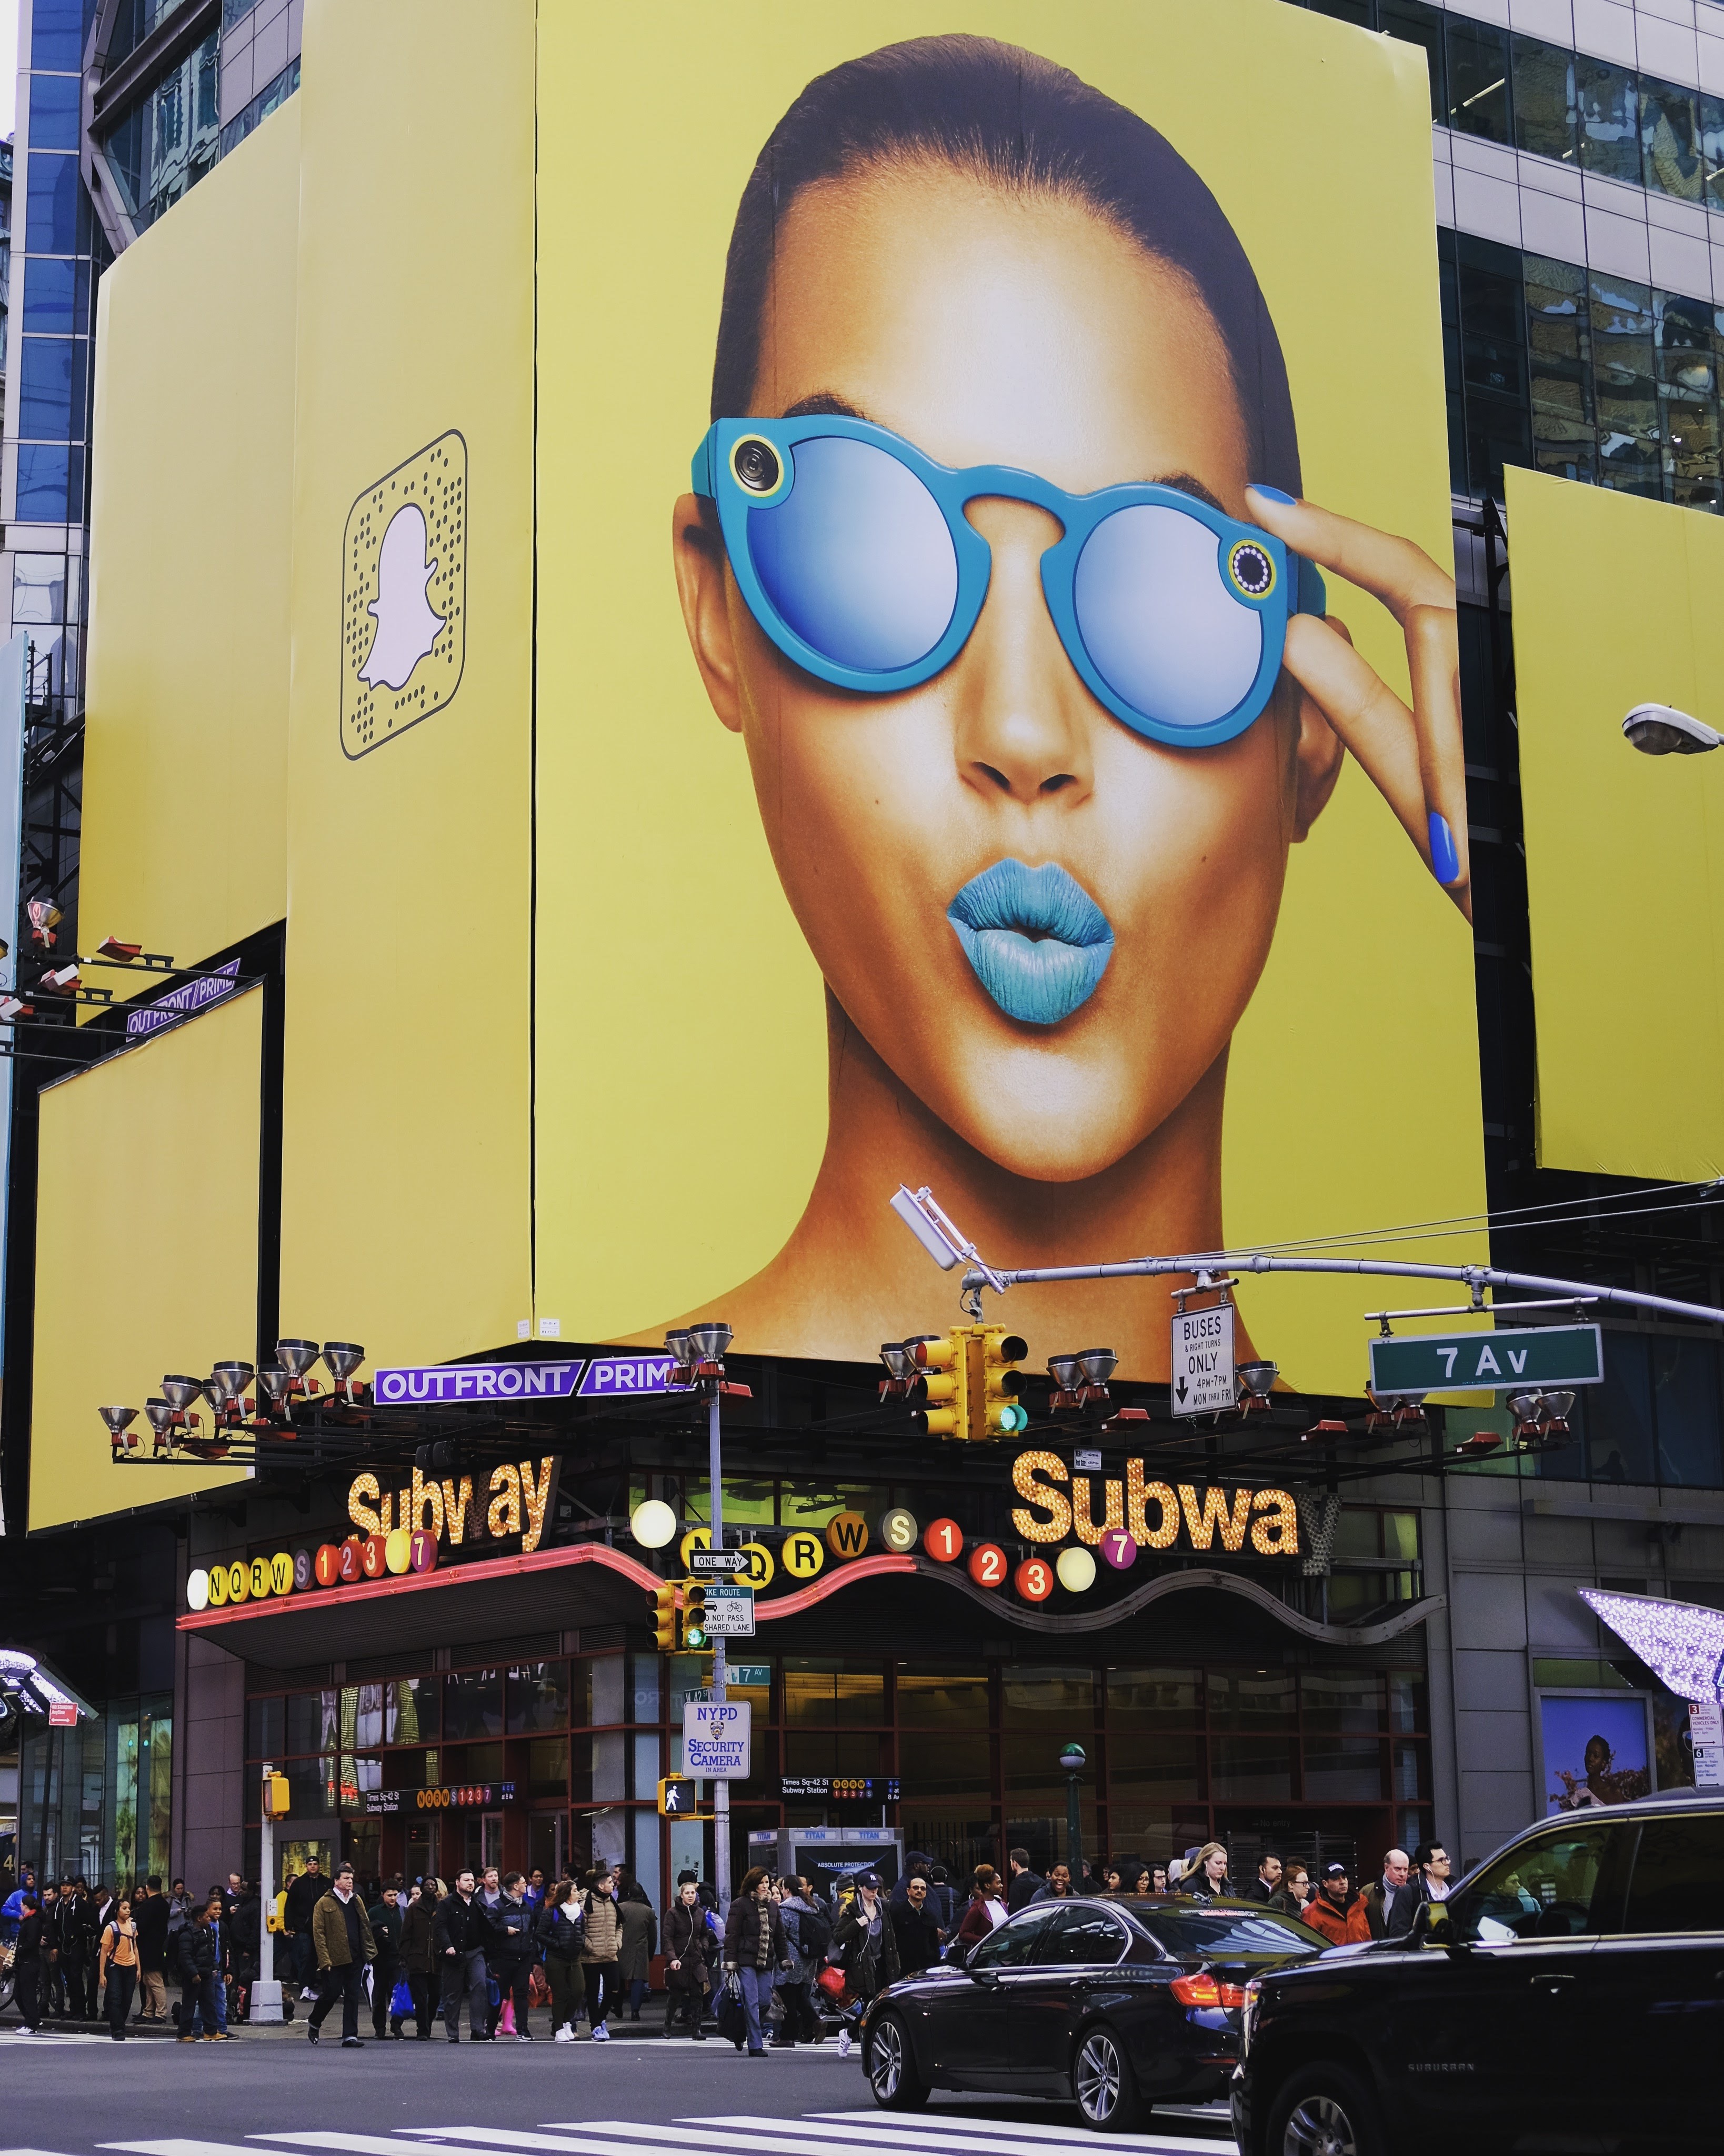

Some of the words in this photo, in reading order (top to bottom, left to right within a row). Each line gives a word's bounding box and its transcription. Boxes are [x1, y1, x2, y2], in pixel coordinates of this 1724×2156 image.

[199, 966, 235, 1002] PRIME
[1184, 1316, 1221, 1340] BUSES
[1190, 1342, 1204, 1352] RIGHT
[1205, 1339, 1221, 1349] TURNS
[1189, 1352, 1218, 1374] ONLY
[1437, 1348, 1458, 1378] 7
[1475, 1345, 1528, 1376] Av
[382, 1365, 571, 1400] OUTFRONT
[1197, 1375, 1227, 1389] 4PM-7PM
[1193, 1393, 1207, 1405] MON
[1209, 1392, 1219, 1401] THRU
[1221, 1389, 1231, 1401] FRI
[348, 1455, 554, 1553] Subway
[699, 1557, 717, 1566] ONE
[725, 1557, 743, 1566] WAY
[795, 1540, 816, 1569] R
[836, 1522, 865, 1553] W
[891, 1515, 910, 1545] S
[940, 1525, 953, 1554] 1
[981, 1551, 1000, 1581] 2
[1027, 1564, 1045, 1595] 3
[1112, 1535, 1128, 1562] 7
[211, 1574, 219, 1598] N
[232, 1564, 242, 1594] Q
[253, 1565, 262, 1590] R
[272, 1562, 286, 1590] W
[296, 1556, 306, 1583] S
[320, 1551, 328, 1578] 1
[343, 1547, 352, 1574] 2
[366, 1541, 375, 1570] 3
[414, 1536, 424, 1565] 7
[743, 1669, 750, 1682] 7
[685, 1692, 691, 1702] W
[694, 1690, 702, 1702] 42
[697, 1708, 738, 1720] NYPD
[1692, 1705, 1698, 1714] 3
[688, 1739, 745, 1752] SECURITY
[690, 1753, 741, 1766] CAMERA
[1696, 1749, 1702, 1758] 6
[366, 1793, 379, 1802] Times
[394, 1791, 399, 1800] St
[460, 1792, 464, 1800] 1
[476, 1791, 480, 1800] 3
[485, 1790, 489, 1799] 7
[366, 1804, 383, 1813] Subway
[383, 1802, 398, 1812] Station
[1408, 2063, 1474, 2072] SUBURBAN
